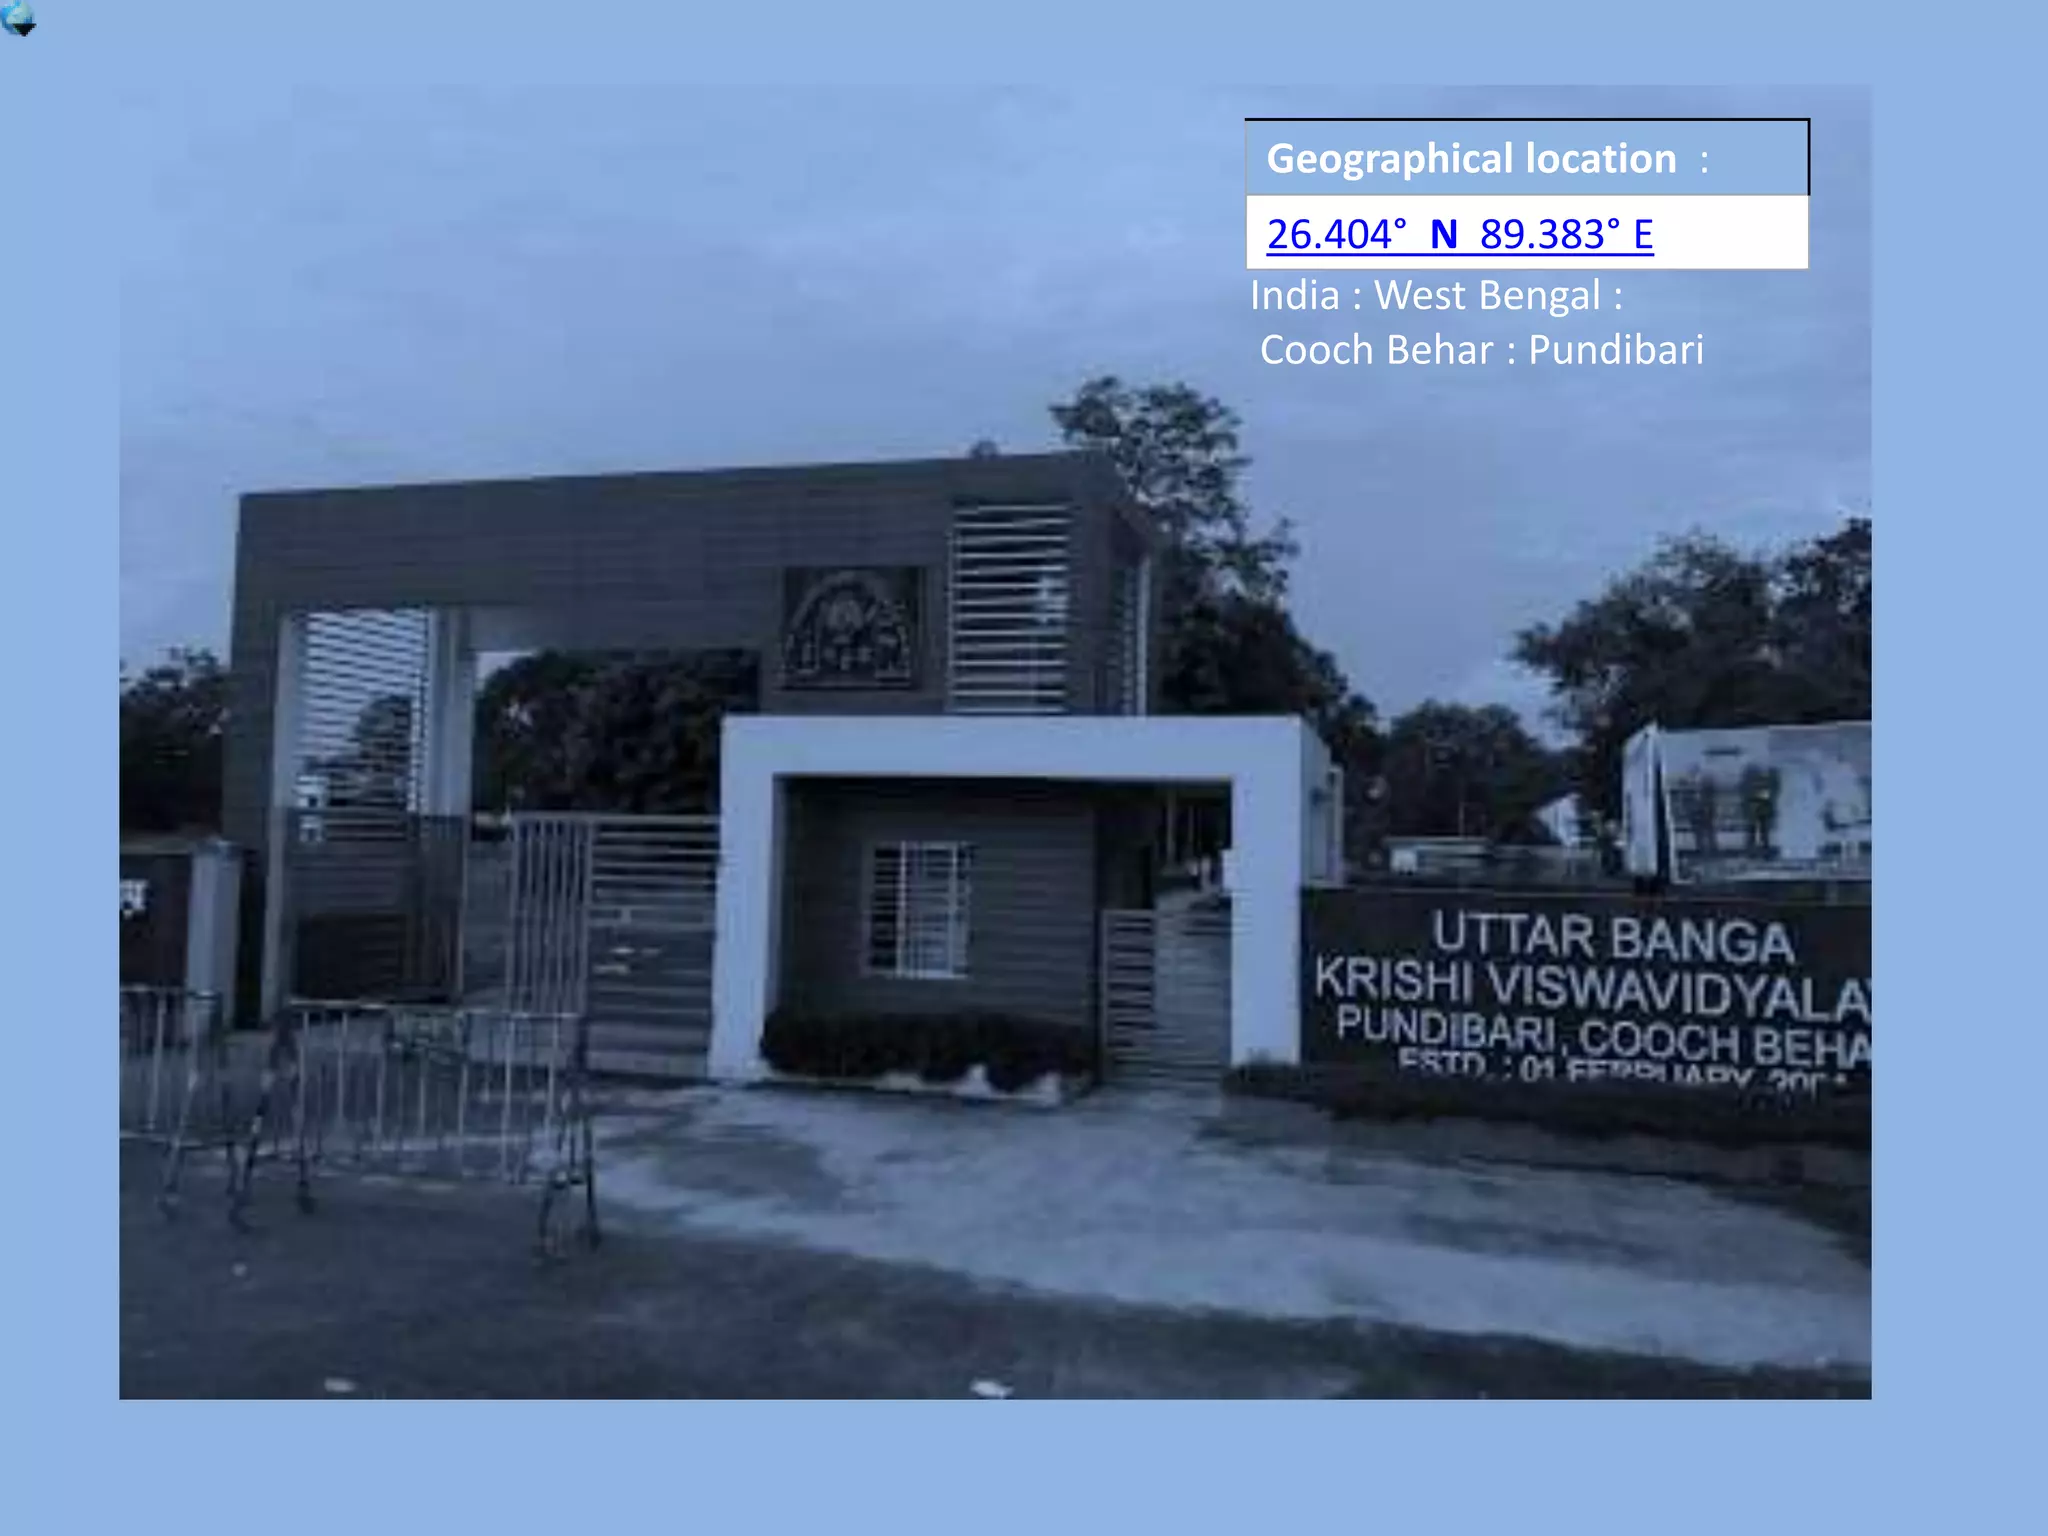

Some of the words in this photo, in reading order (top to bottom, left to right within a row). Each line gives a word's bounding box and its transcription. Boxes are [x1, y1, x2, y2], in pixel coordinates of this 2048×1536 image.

[1433, 909, 1594, 957] UTTAR
[1612, 917, 1796, 964] BANGA
[1316, 953, 1473, 1004] KRISHI
[1488, 959, 1872, 1024] VISWAVIDYALA
[1338, 1004, 1568, 1058] PUNDIBARI,
[1577, 1019, 1740, 1064] COOCH
